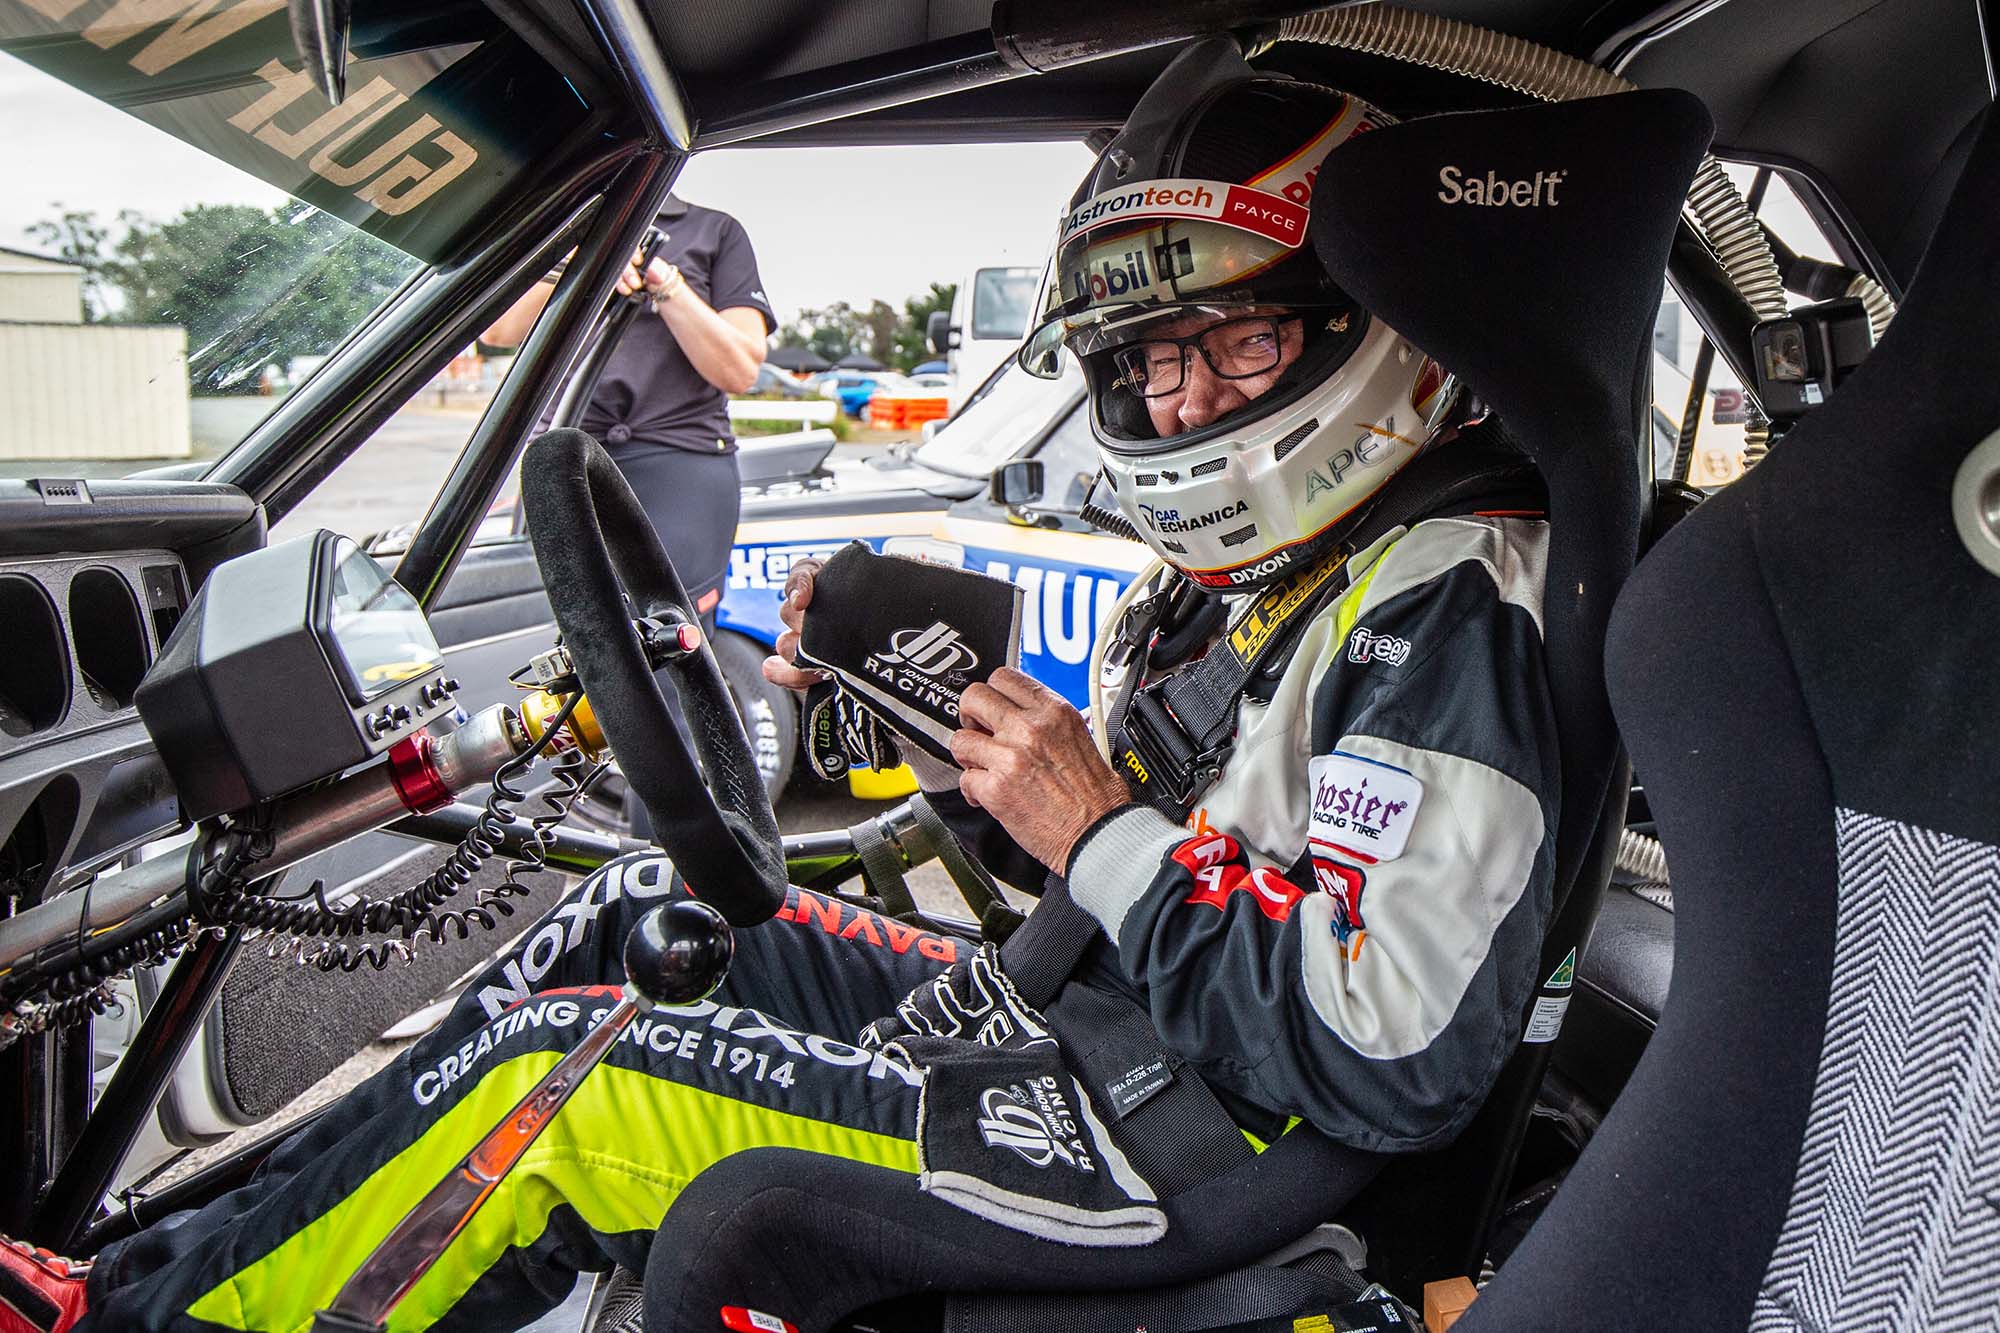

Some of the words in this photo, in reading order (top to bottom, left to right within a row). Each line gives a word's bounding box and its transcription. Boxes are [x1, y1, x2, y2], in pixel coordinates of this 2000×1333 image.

[1438, 165, 1564, 207] Sabelt
[1064, 186, 1214, 236] Astrontech
[1233, 202, 1297, 231] PAYCE
[1306, 415, 1416, 503] APEX
[1155, 509, 1180, 522] CAR
[1157, 499, 1250, 534] ECHANICA
[1229, 550, 1292, 585] DIXON
[864, 656, 960, 717] RACING
[899, 667, 932, 686] JOHN
[1124, 749, 1150, 784] rpm
[1351, 820, 1382, 841] TIRE
[413, 1001, 581, 1106] CREATING
[588, 1008, 703, 1060] SNCE
[710, 1038, 796, 1089] 1914
[1030, 1080, 1051, 1113] BOWE
[1123, 1092, 1139, 1105] MADE
[1138, 1088, 1146, 1097] IN
[1041, 1075, 1096, 1172] RACING
[1043, 1111, 1067, 1140] JOHN
